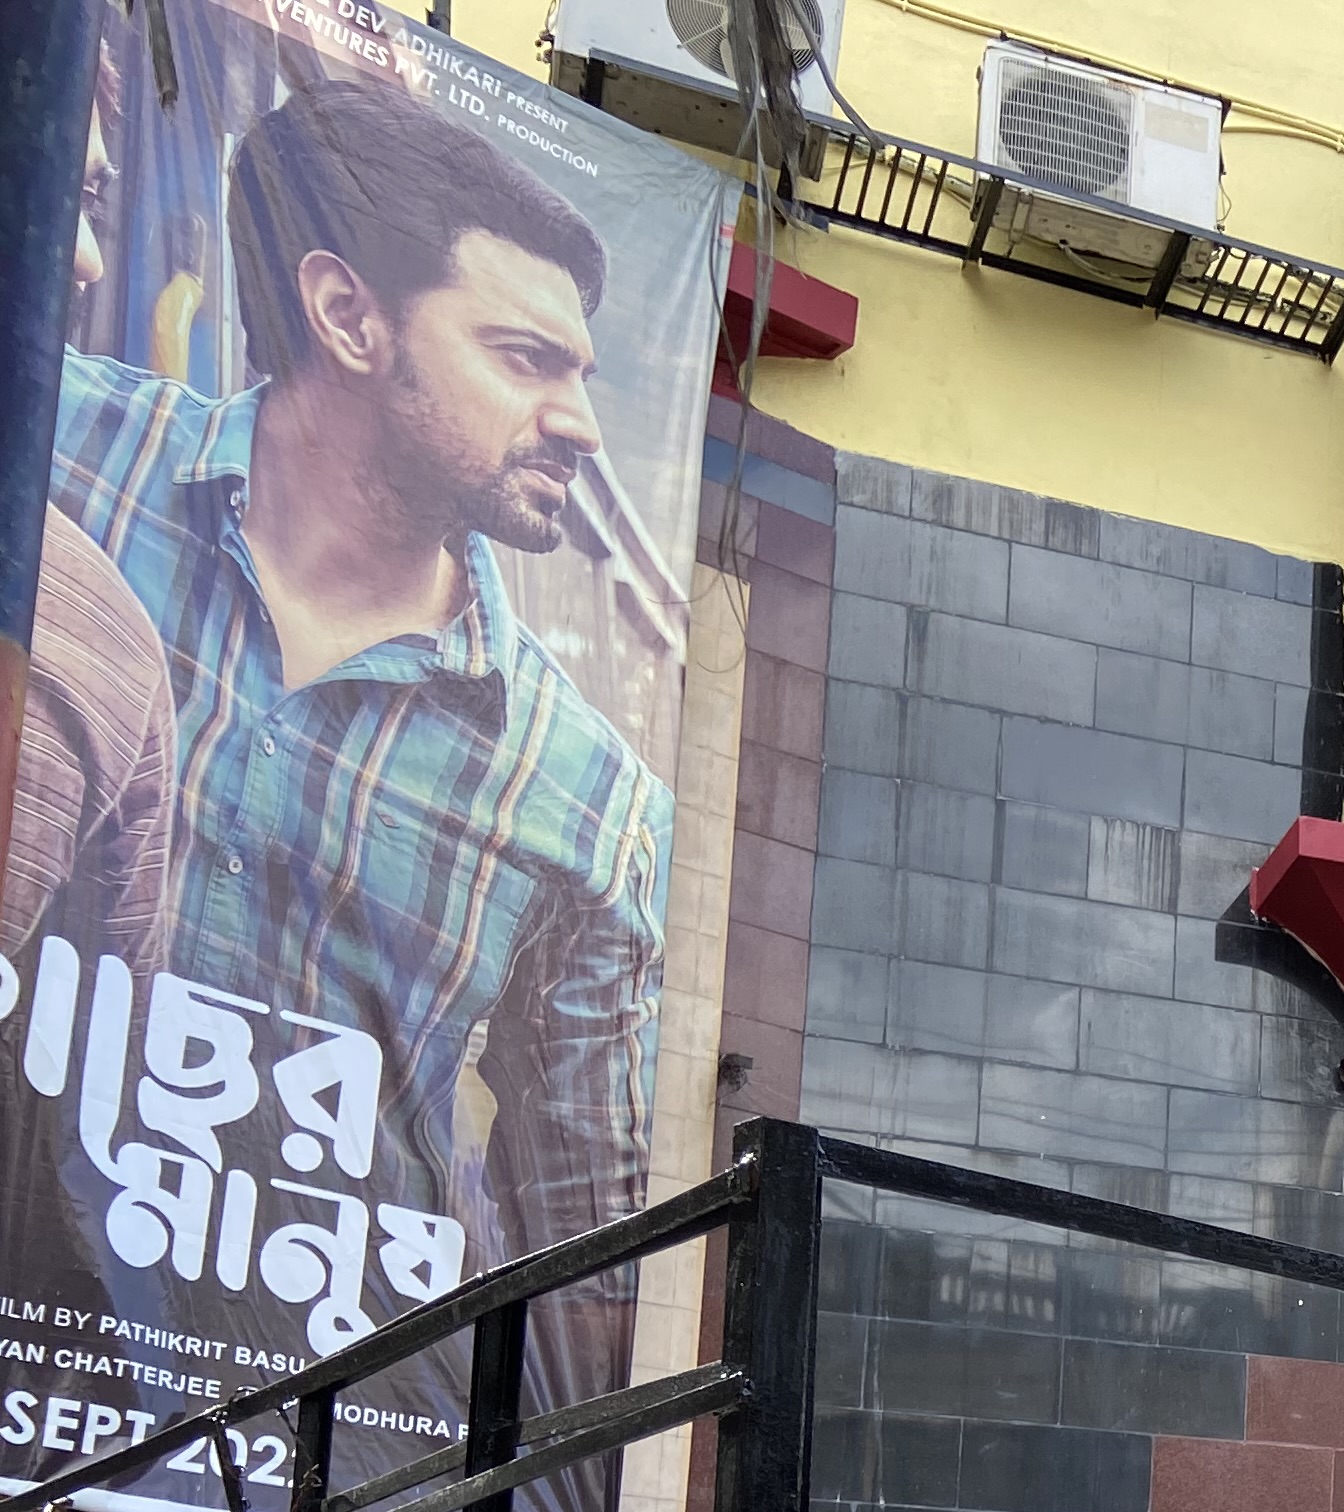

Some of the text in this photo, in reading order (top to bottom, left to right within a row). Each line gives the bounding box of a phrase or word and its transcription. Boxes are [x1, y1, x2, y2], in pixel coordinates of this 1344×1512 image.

[276, 0, 600, 179] VENTURES PVT. LTD. PRODUCTION
[338, 0, 569, 135] DEV ADHIKARI PRESENT
[53, 1307, 93, 1331] BY
[99, 1314, 228, 1363] PATHIKRIT
[234, 1345, 306, 1377] BASU
[54, 1347, 222, 1400] CHATTERJEE
[165, 1428, 299, 1490] 202
